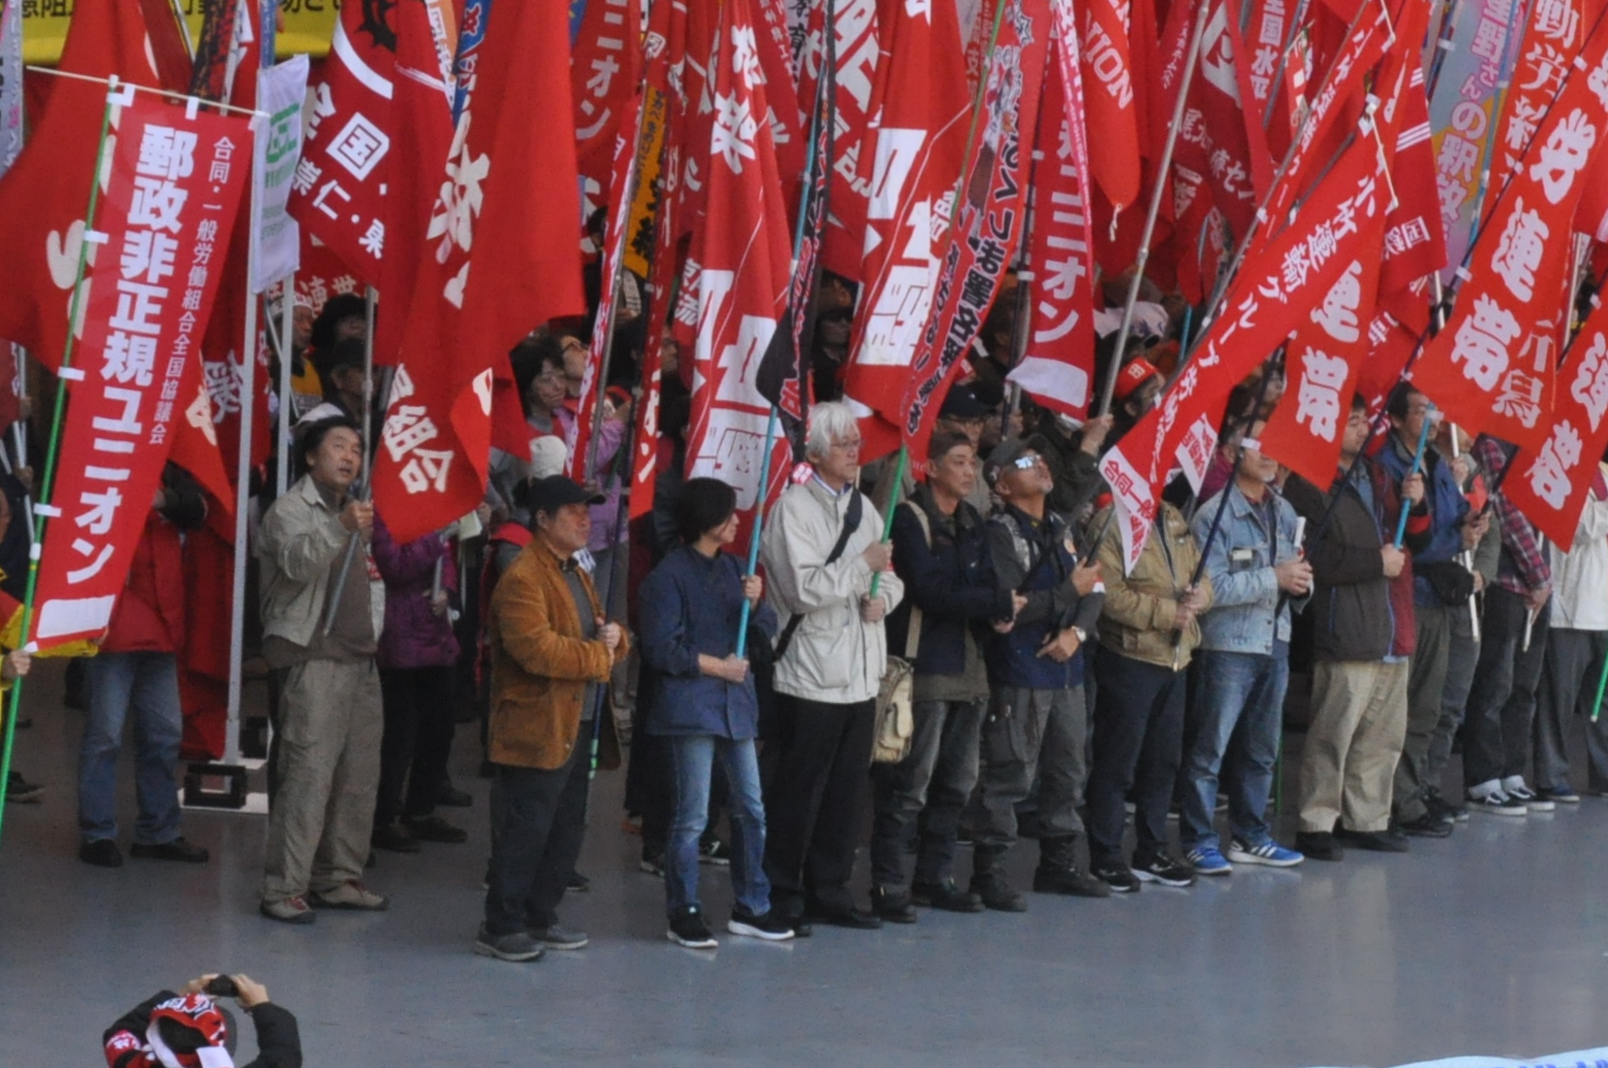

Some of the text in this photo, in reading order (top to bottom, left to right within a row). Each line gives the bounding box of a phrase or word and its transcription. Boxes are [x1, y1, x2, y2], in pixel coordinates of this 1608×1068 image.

[66, 122, 198, 585] 郵政非正規ユニオン
[149, 133, 235, 446] 合同・一般労働組合全国協議会
